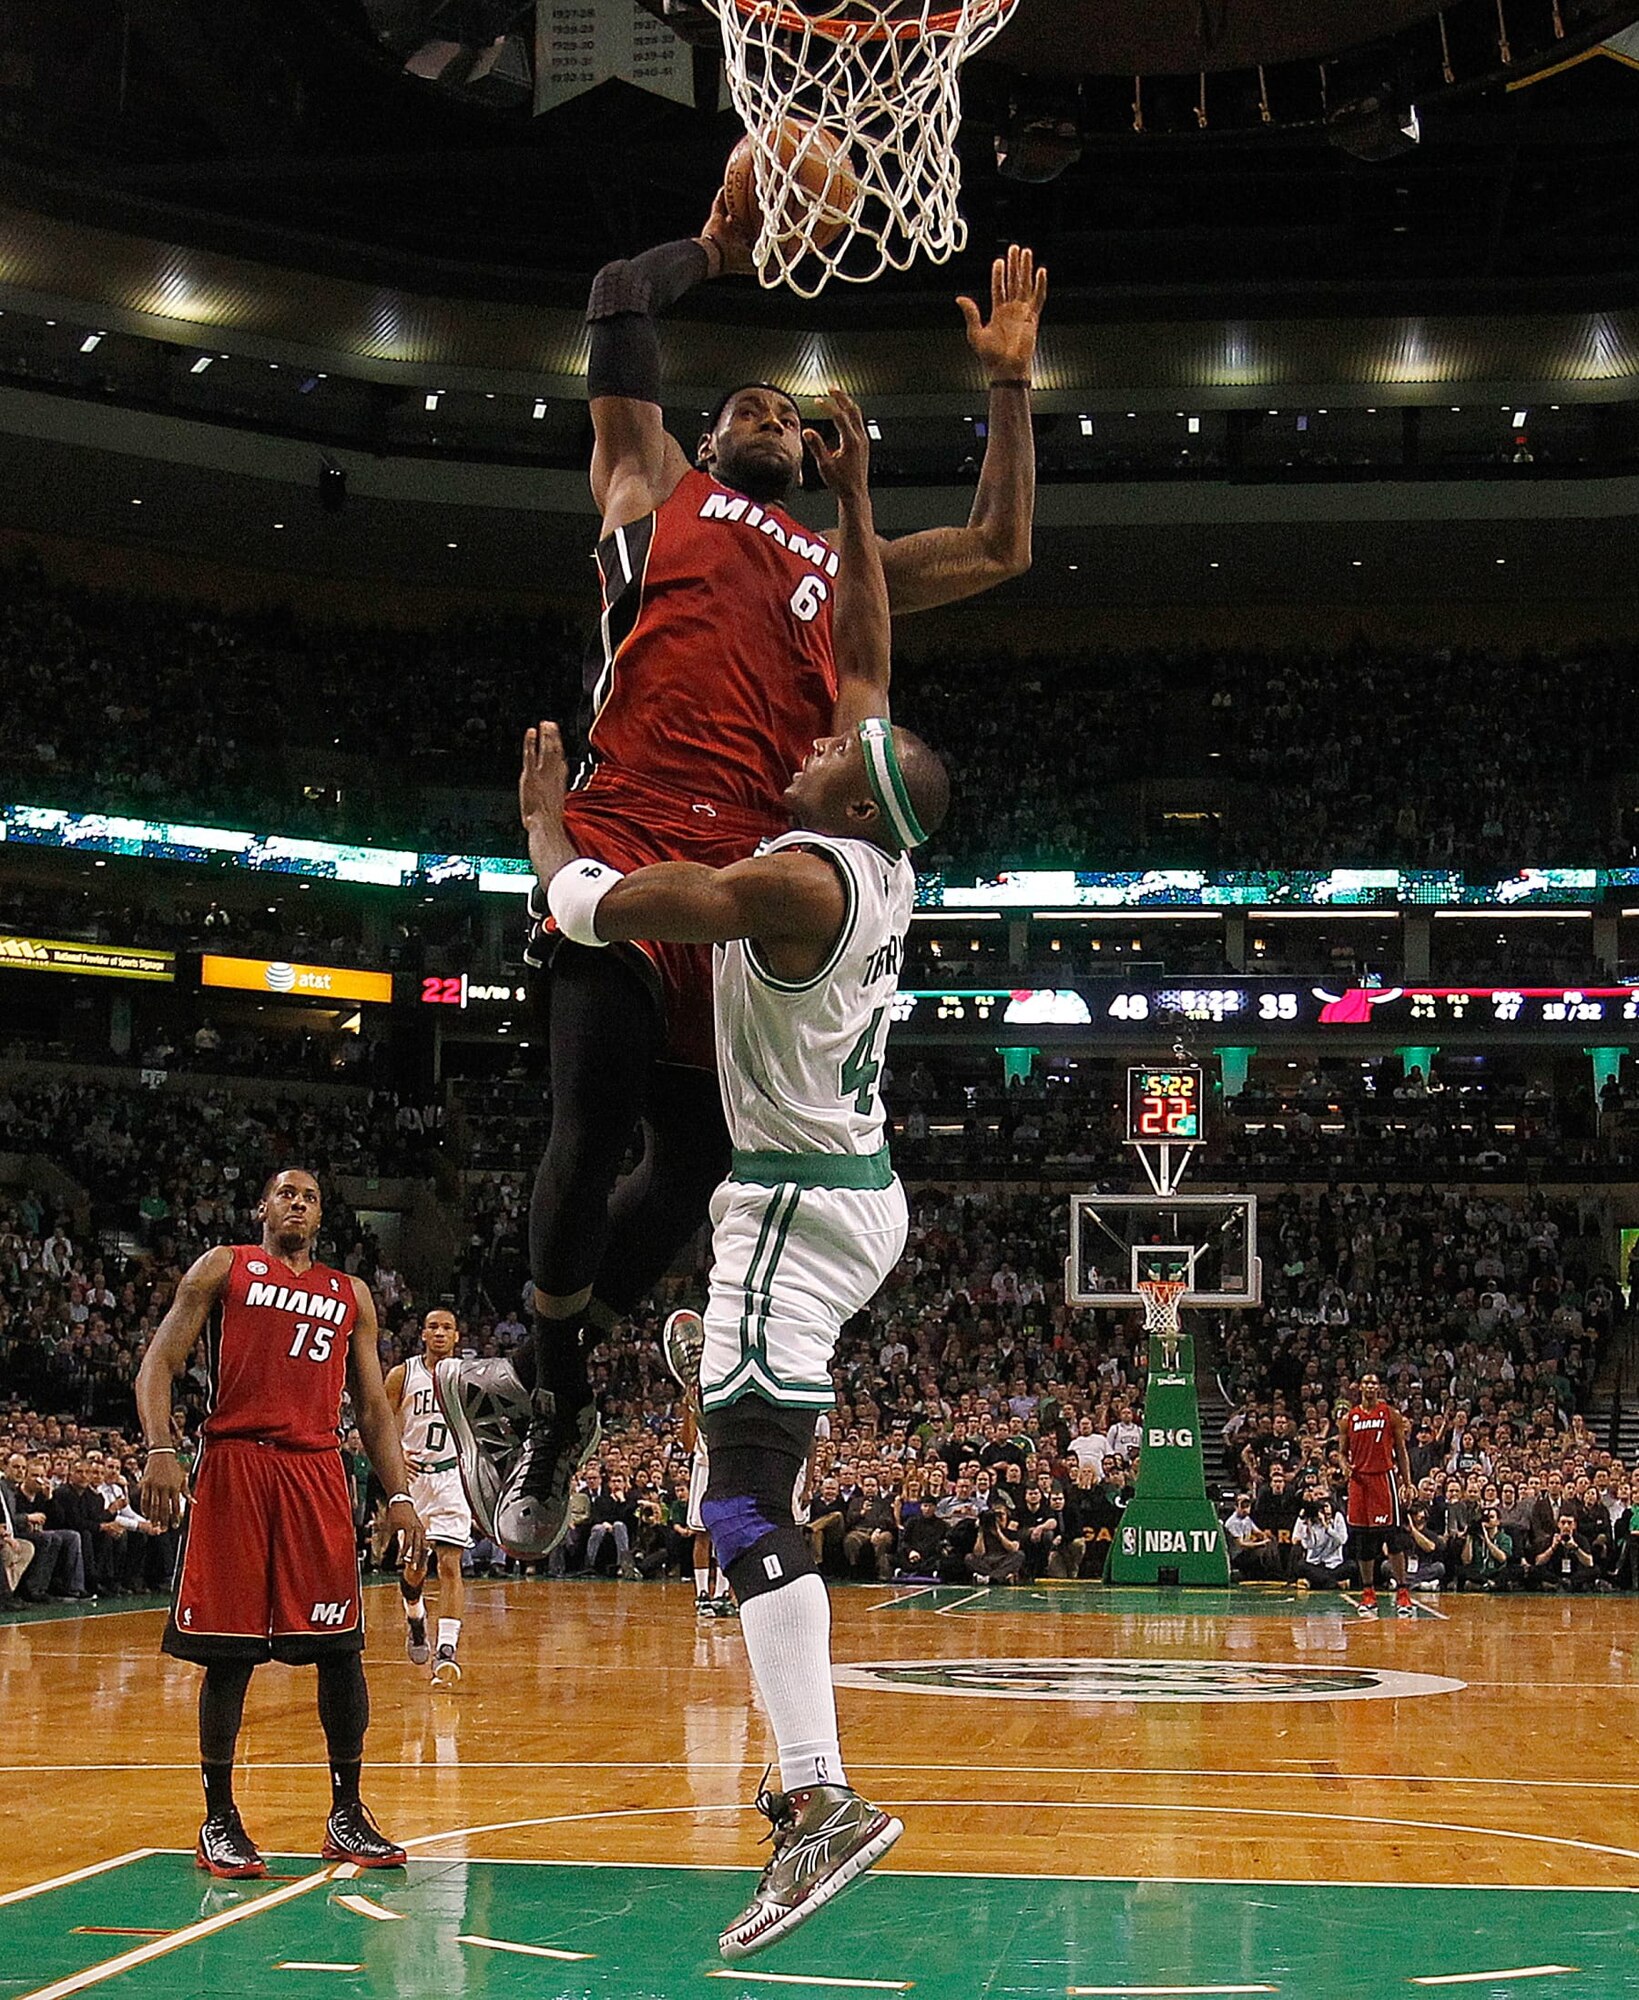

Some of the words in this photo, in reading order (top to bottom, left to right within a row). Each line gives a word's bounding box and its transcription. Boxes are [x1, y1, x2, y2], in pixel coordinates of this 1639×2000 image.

[700, 493, 839, 578] MIAMI
[789, 573, 828, 622] 6
[82, 954, 110, 966] Provider
[110, 956, 118, 966] of
[118, 957, 139, 969] Sports
[298, 972, 332, 991] at&t
[421, 977, 460, 1004] 22
[1107, 993, 1149, 1021] 48
[1179, 989, 1240, 1011] 5:22
[1258, 993, 1298, 1020] 35
[1494, 1003, 1521, 1021] 47
[840, 1006, 885, 1116] 4
[1147, 1075, 1195, 1097] 5:22
[1142, 1097, 1188, 1135] 22
[245, 1282, 347, 1326] MIAMI
[288, 1322, 336, 1363] 15
[425, 1421, 448, 1453] 0
[1353, 1418, 1386, 1432] MIAMI
[1375, 1430, 1383, 1443] 1
[1145, 1529, 1188, 1553] NBA
[1189, 1529, 1219, 1553] TV
